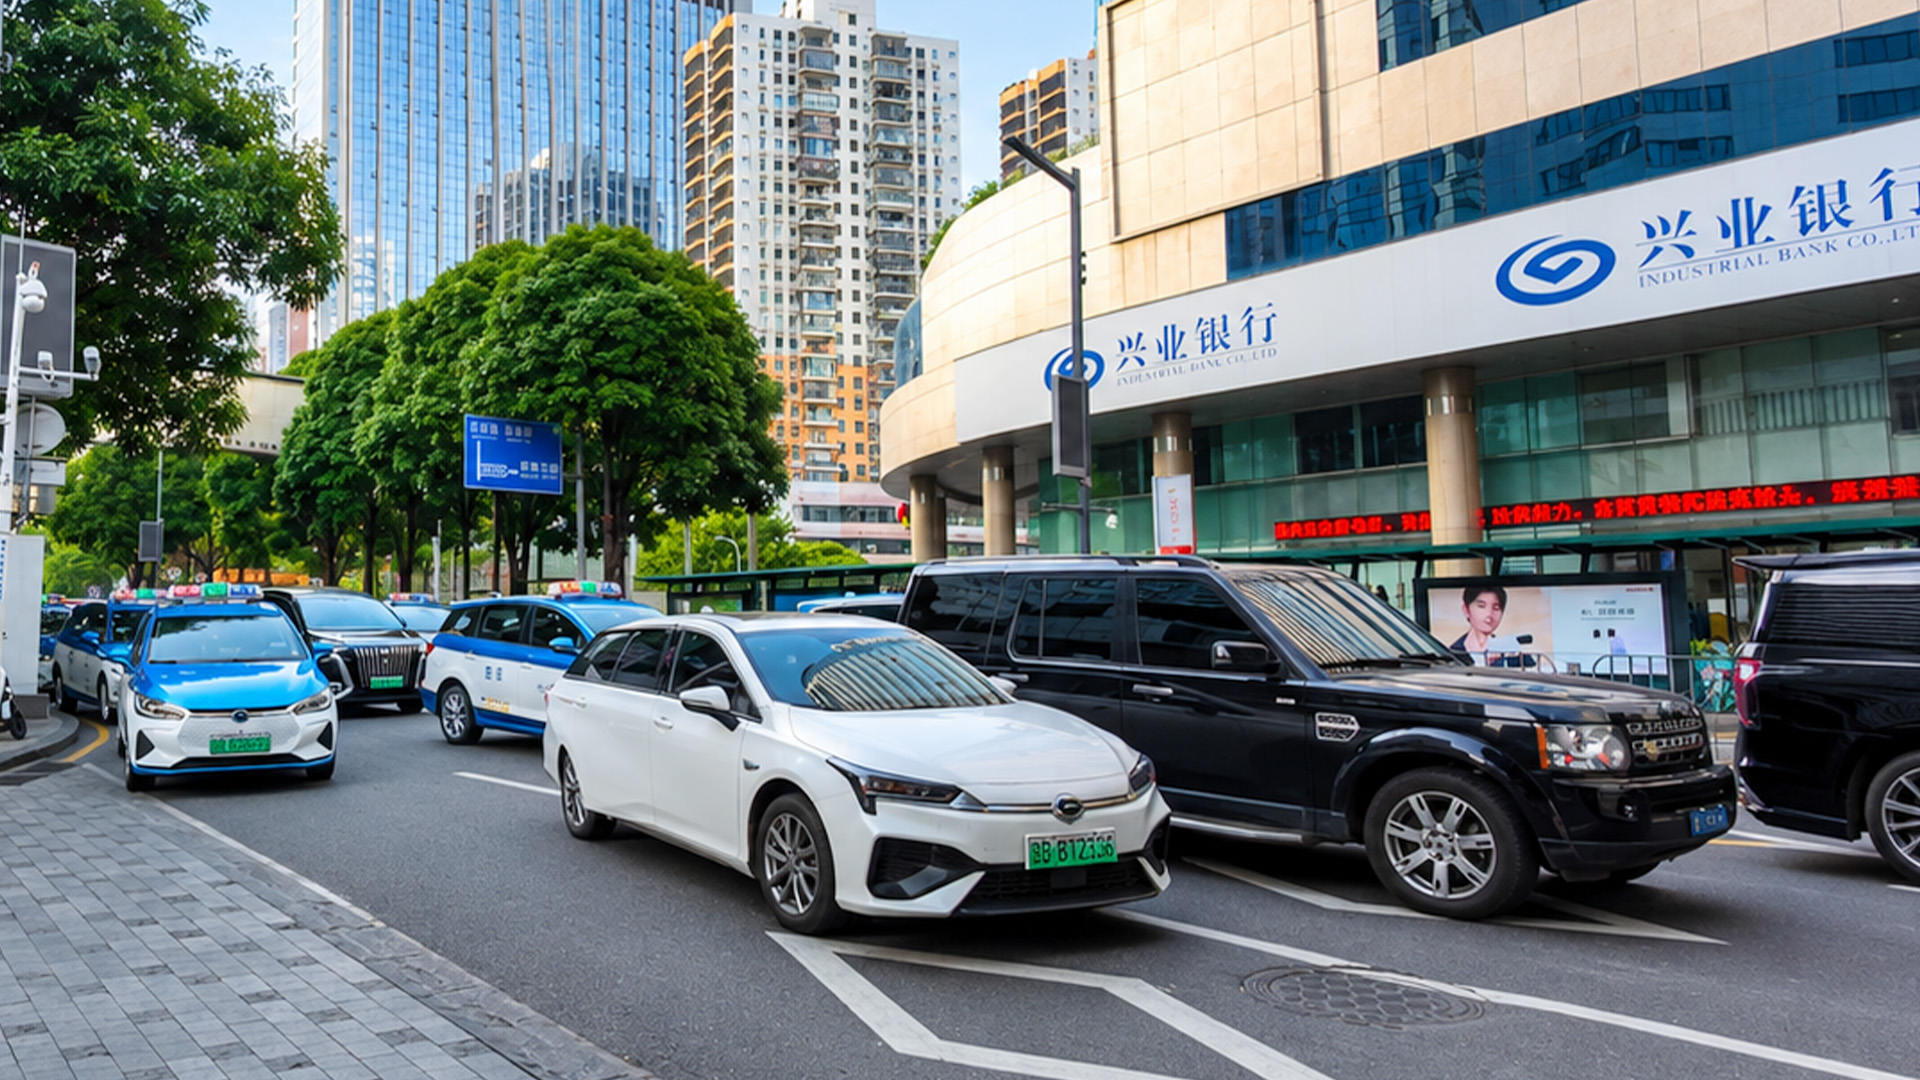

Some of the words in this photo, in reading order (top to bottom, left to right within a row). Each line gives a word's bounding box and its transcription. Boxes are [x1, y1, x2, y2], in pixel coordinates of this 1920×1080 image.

[1635, 165, 1920, 267] 兴业银行
[1638, 253, 1769, 288] INDUSTRIAL
[1778, 240, 1838, 262] BANK
[1116, 302, 1277, 373] 兴业银行
